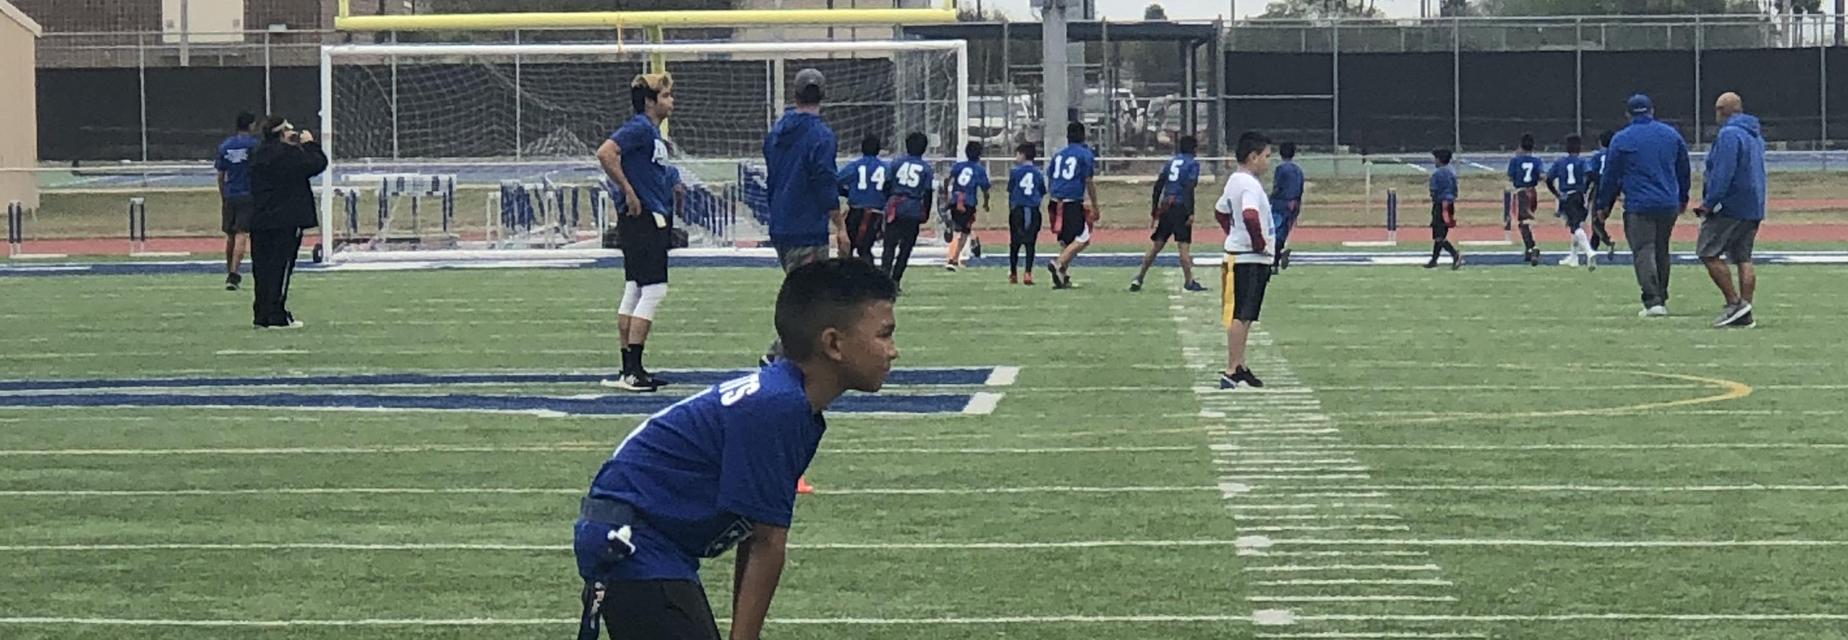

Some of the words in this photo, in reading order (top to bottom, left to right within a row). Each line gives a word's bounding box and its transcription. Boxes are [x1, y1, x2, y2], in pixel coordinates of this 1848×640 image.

[857, 165, 885, 190] 14
[896, 162, 924, 187] 45
[957, 167, 973, 186] 6
[1053, 155, 1077, 180] 13
[1169, 159, 1184, 181] 5
[1521, 162, 1533, 182] 7
[1566, 163, 1576, 184] 1
[1020, 172, 1034, 195] 4
